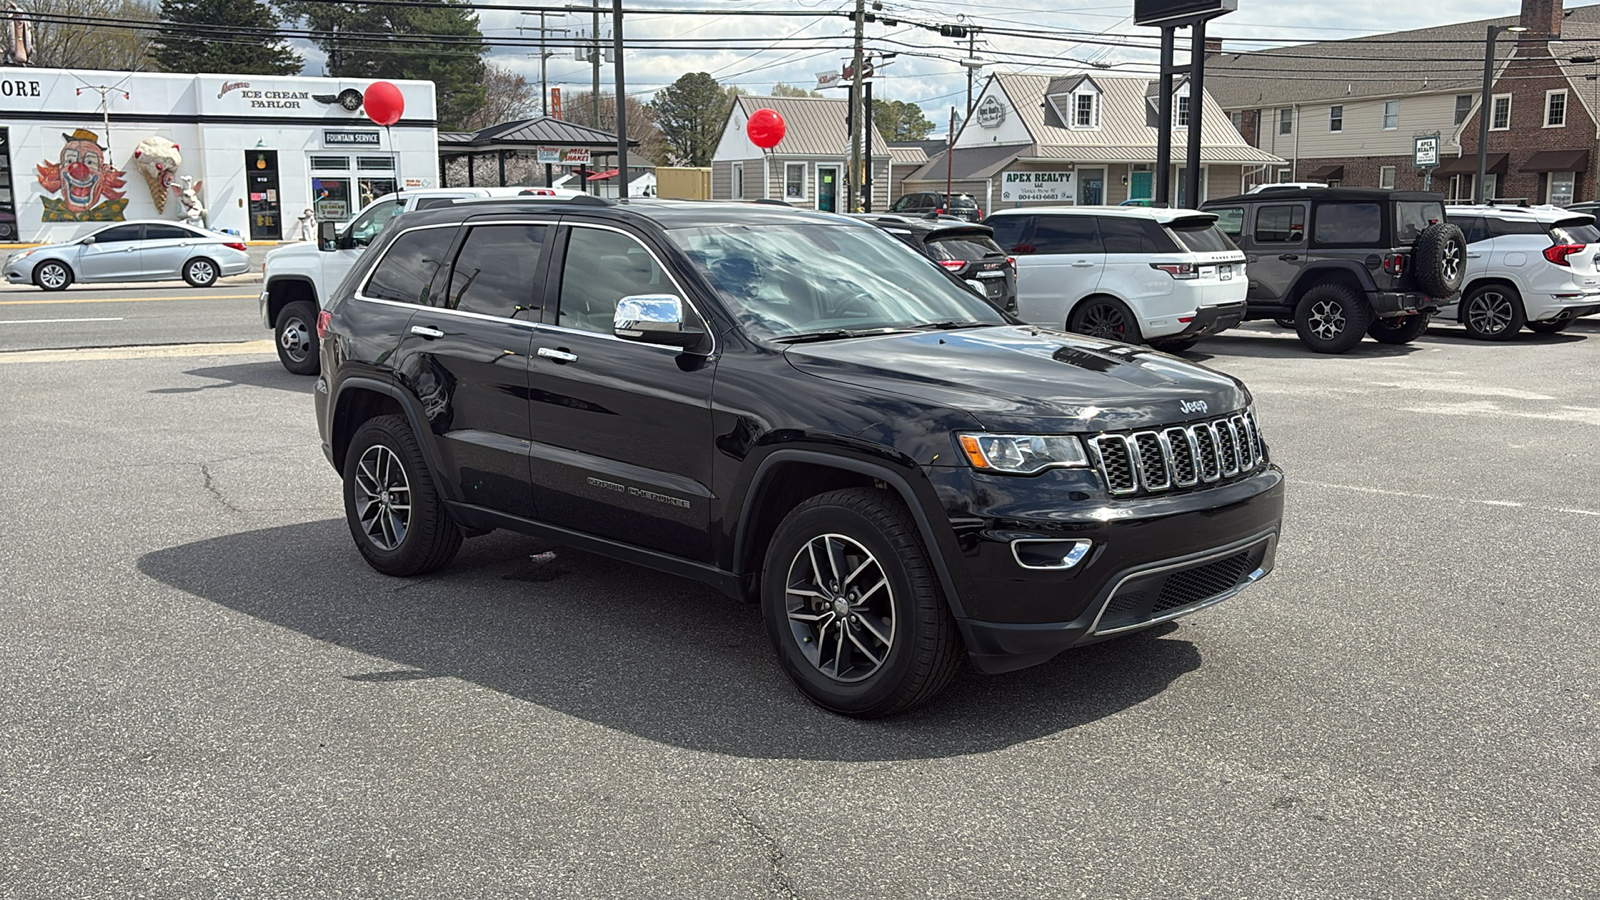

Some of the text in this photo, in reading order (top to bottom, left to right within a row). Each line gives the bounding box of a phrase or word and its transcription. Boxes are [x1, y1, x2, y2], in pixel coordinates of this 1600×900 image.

[241, 90, 309, 99] ICE CREAM
[251, 100, 301, 109] PARLOR
[326, 133, 379, 143] FOUNTAIN SERVICE
[1006, 173, 1072, 183] APEX REALTY
[1180, 400, 1208, 414] Jeep
[587, 477, 690, 508] GRAND CHEROKEE
